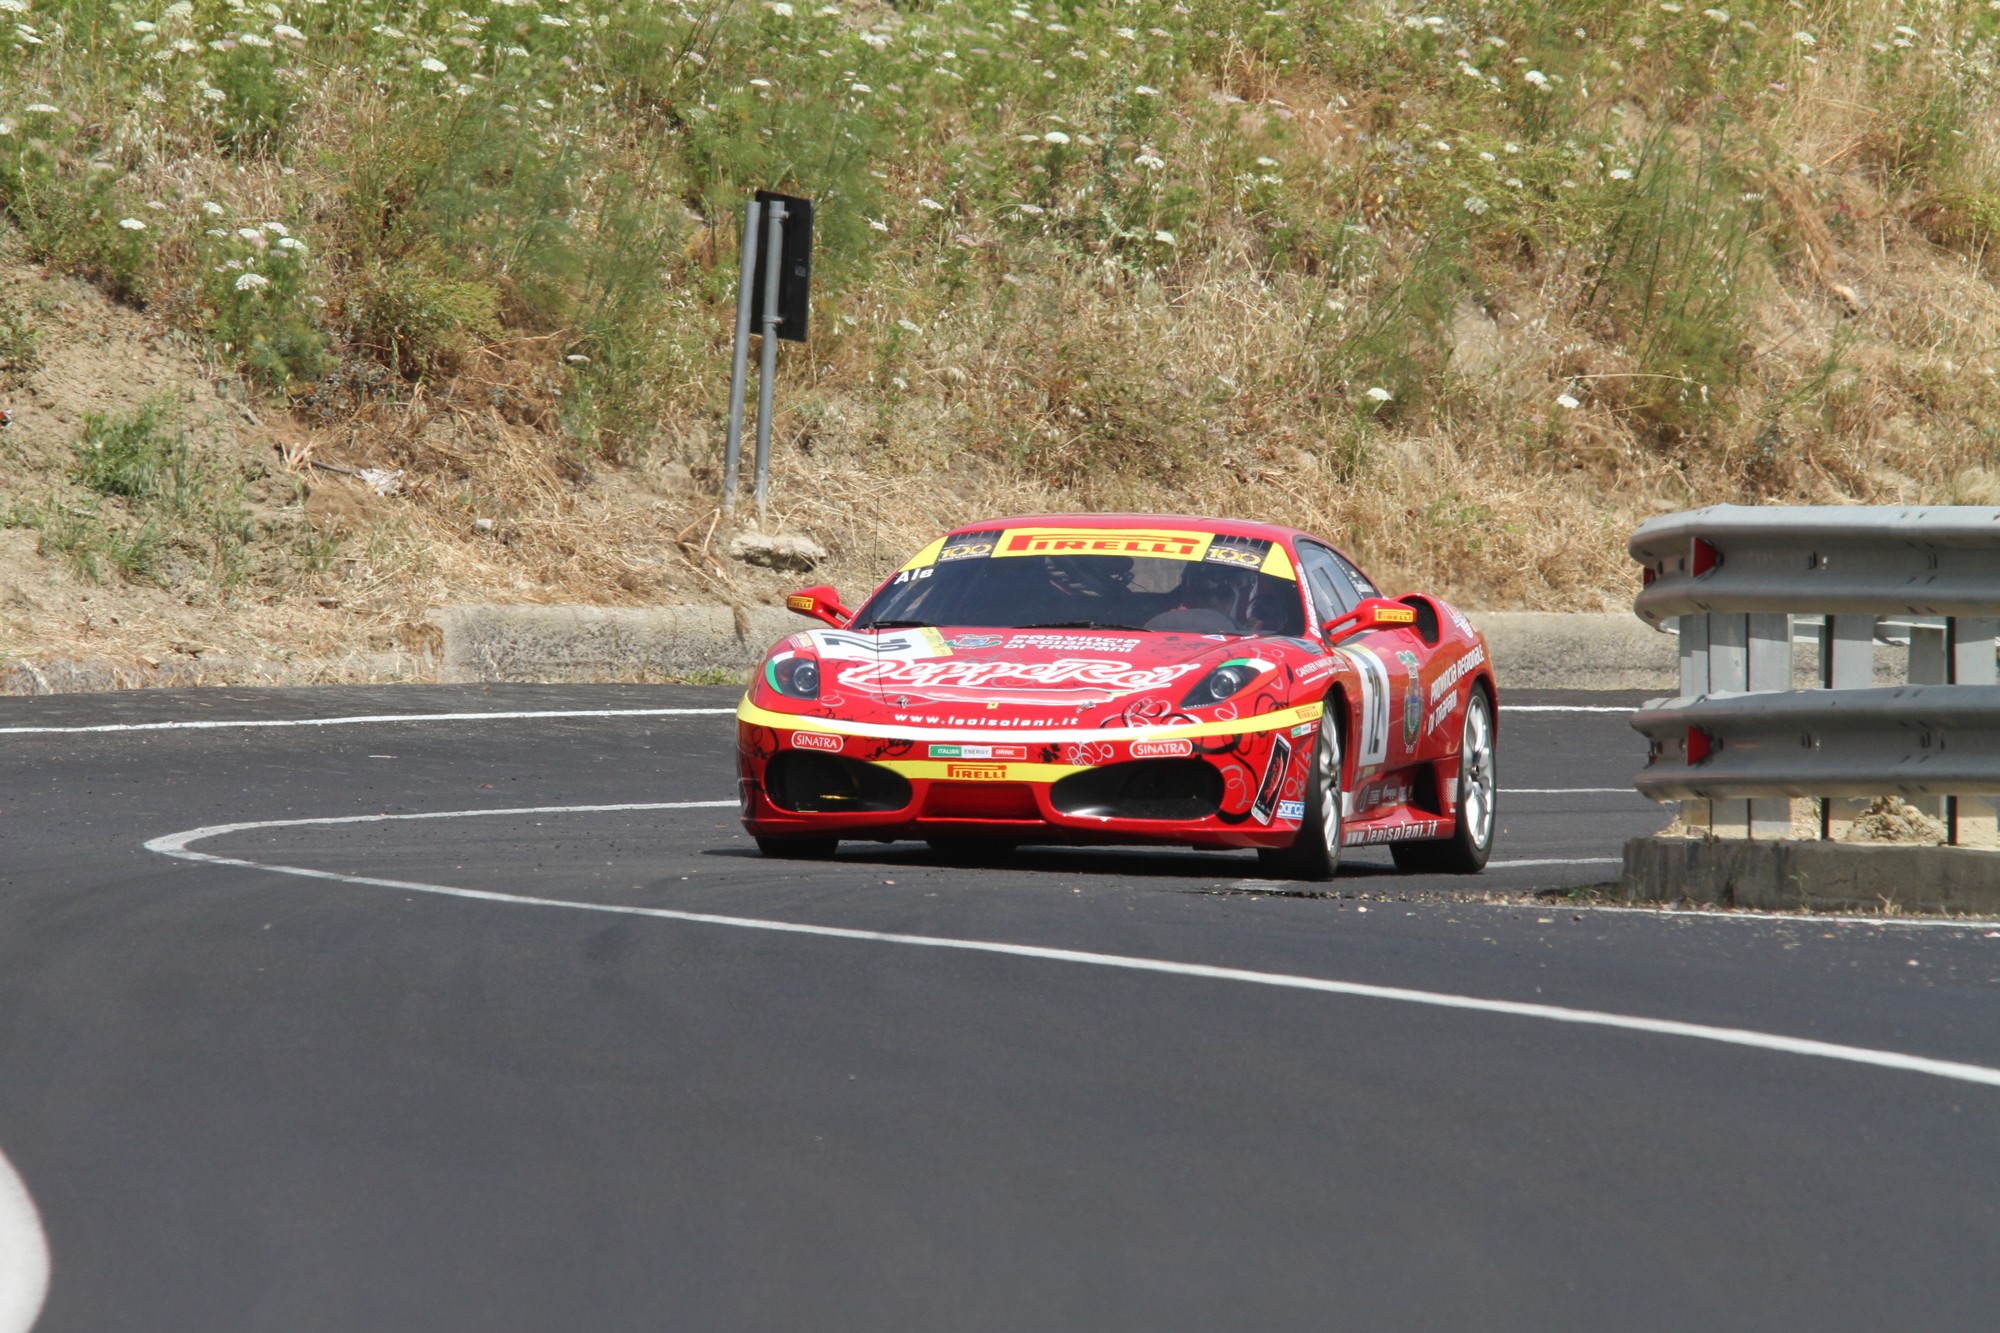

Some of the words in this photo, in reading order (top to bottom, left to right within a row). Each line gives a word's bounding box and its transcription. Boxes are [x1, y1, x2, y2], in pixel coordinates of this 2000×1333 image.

[941, 544, 992, 559] 100
[1006, 533, 1201, 555] PIRELLI
[1208, 548, 1261, 565] 100
[893, 568, 934, 585] Ale
[1377, 610, 1412, 621] PIRELLI
[796, 733, 838, 750] SINATRA
[1136, 742, 1187, 755] SINATRA
[995, 748, 1015, 756] DRINK
[947, 763, 1008, 779] PIRELLI
